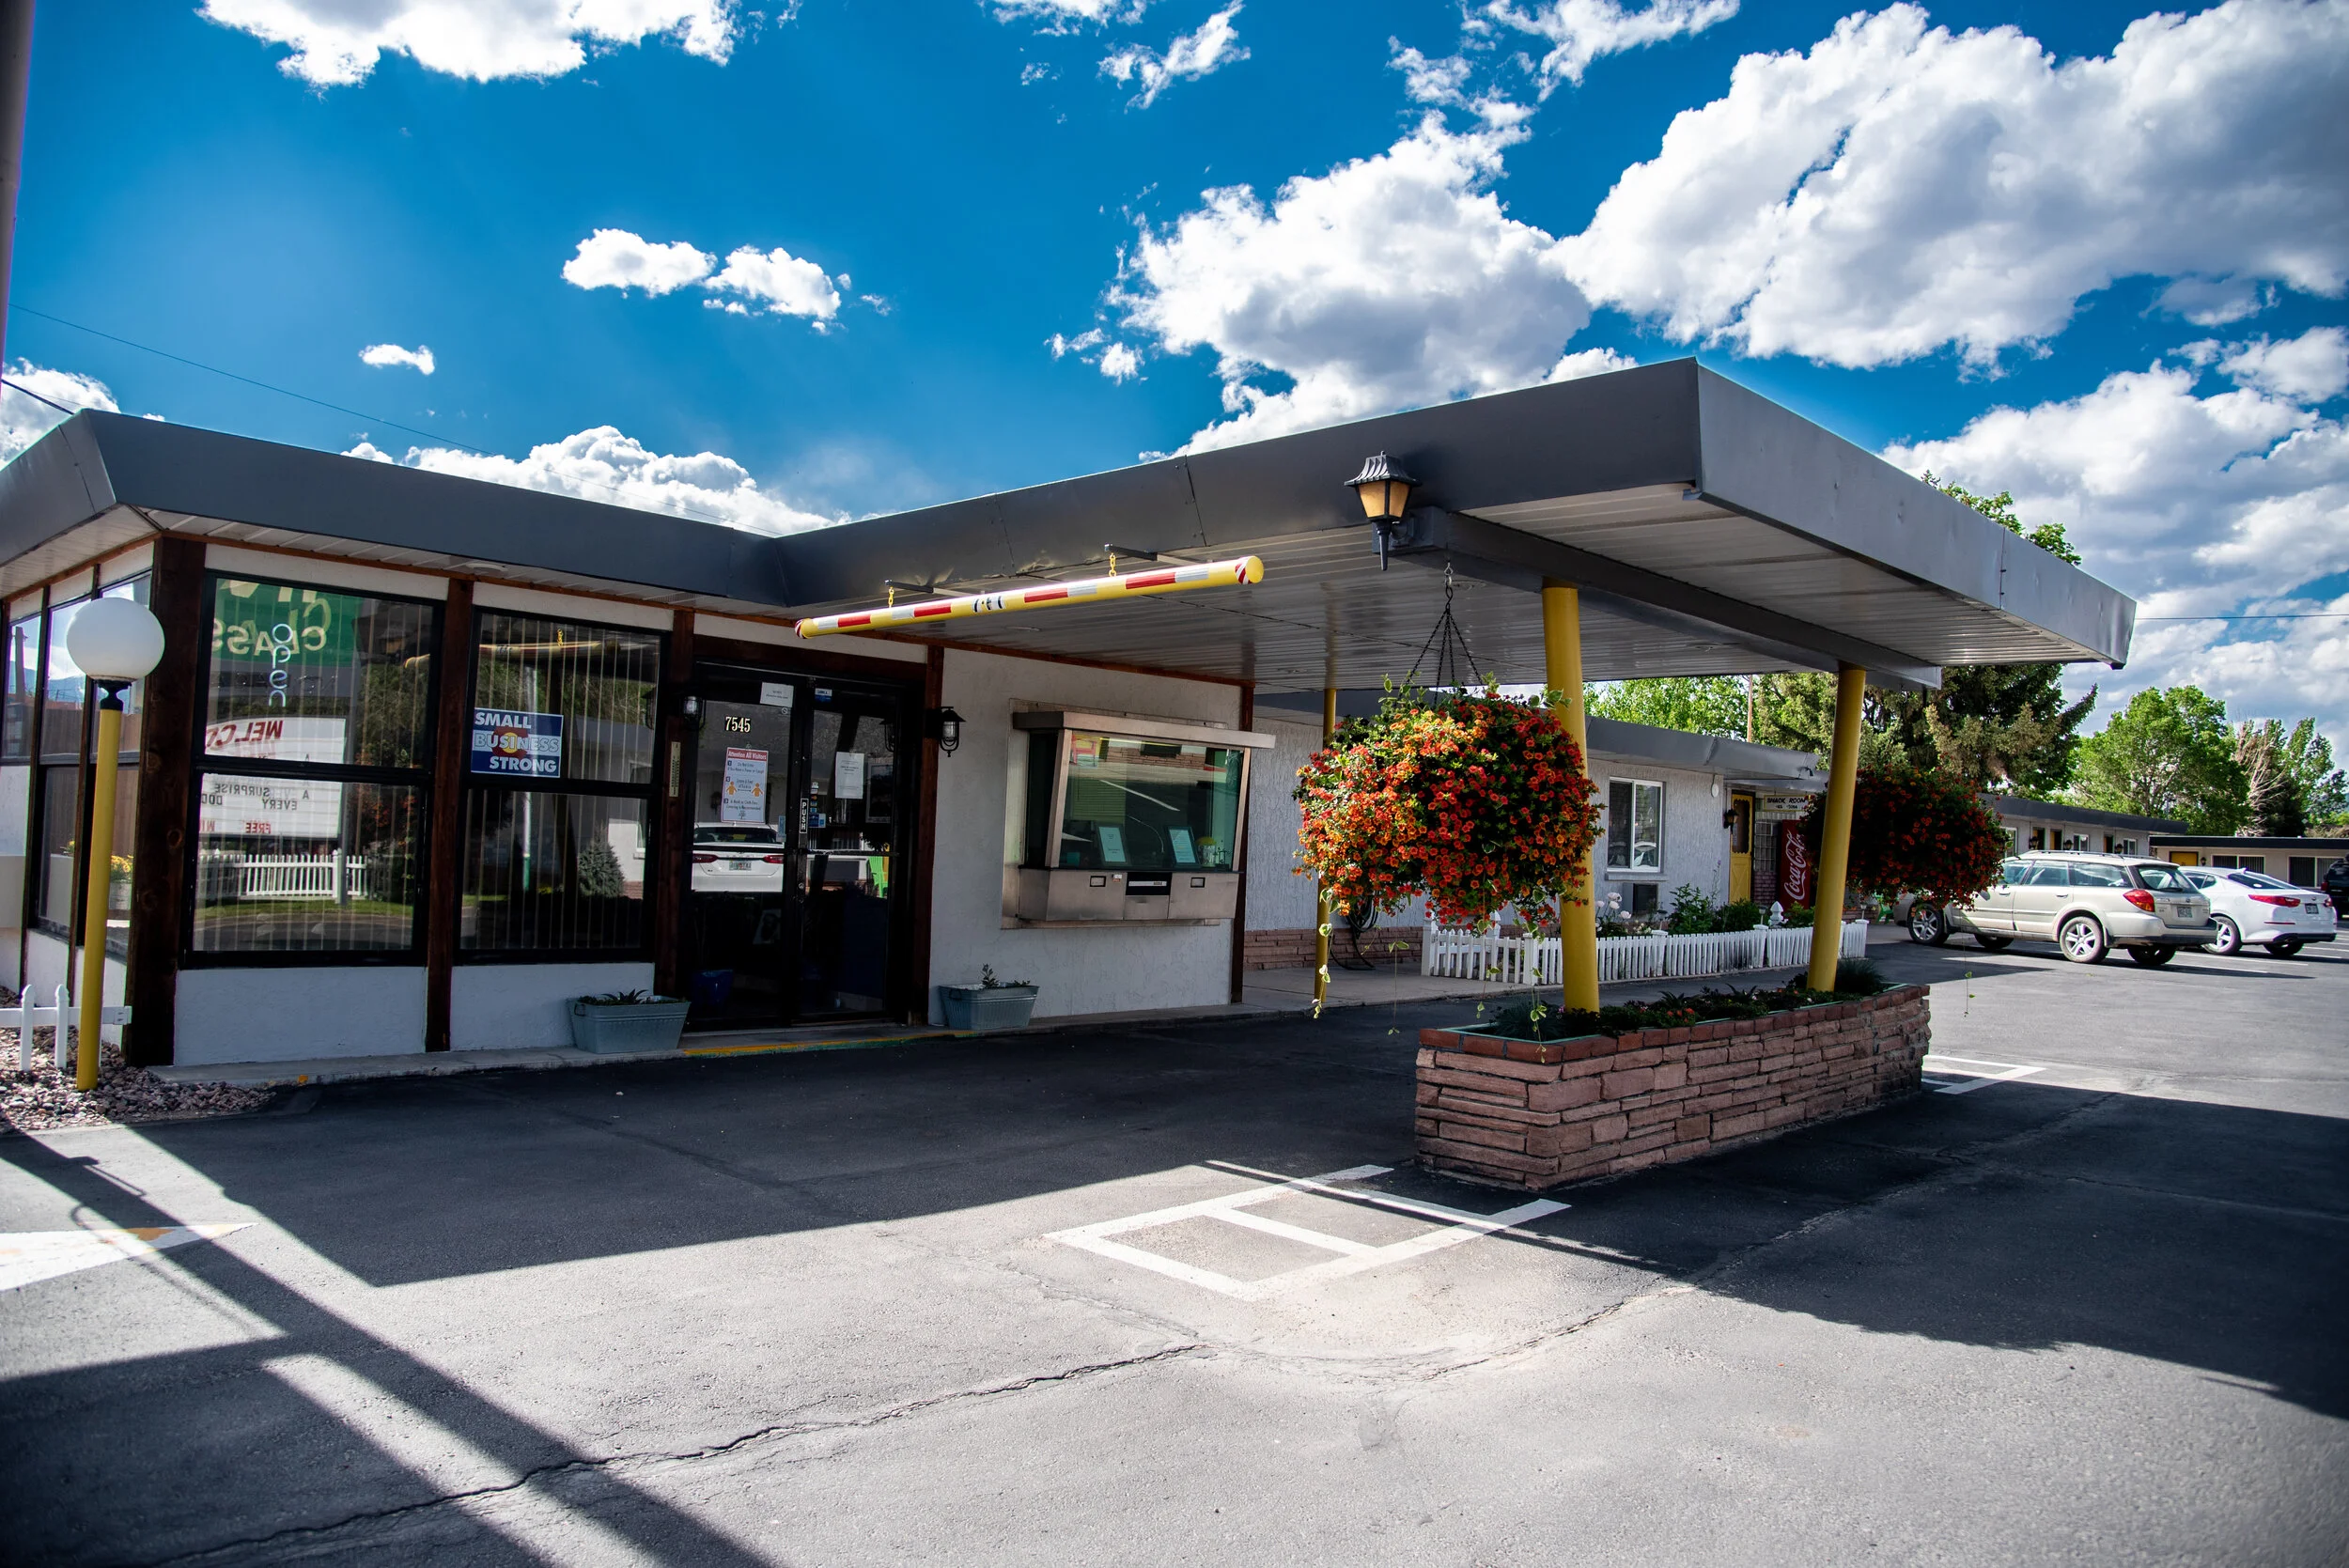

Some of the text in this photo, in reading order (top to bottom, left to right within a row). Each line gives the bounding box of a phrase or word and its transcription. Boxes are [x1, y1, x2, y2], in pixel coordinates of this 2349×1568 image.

[474, 712, 532, 729] SMALL
[725, 716, 751, 733] 7545
[474, 733, 559, 753] BUSINESS
[490, 756, 557, 773] STRONG
